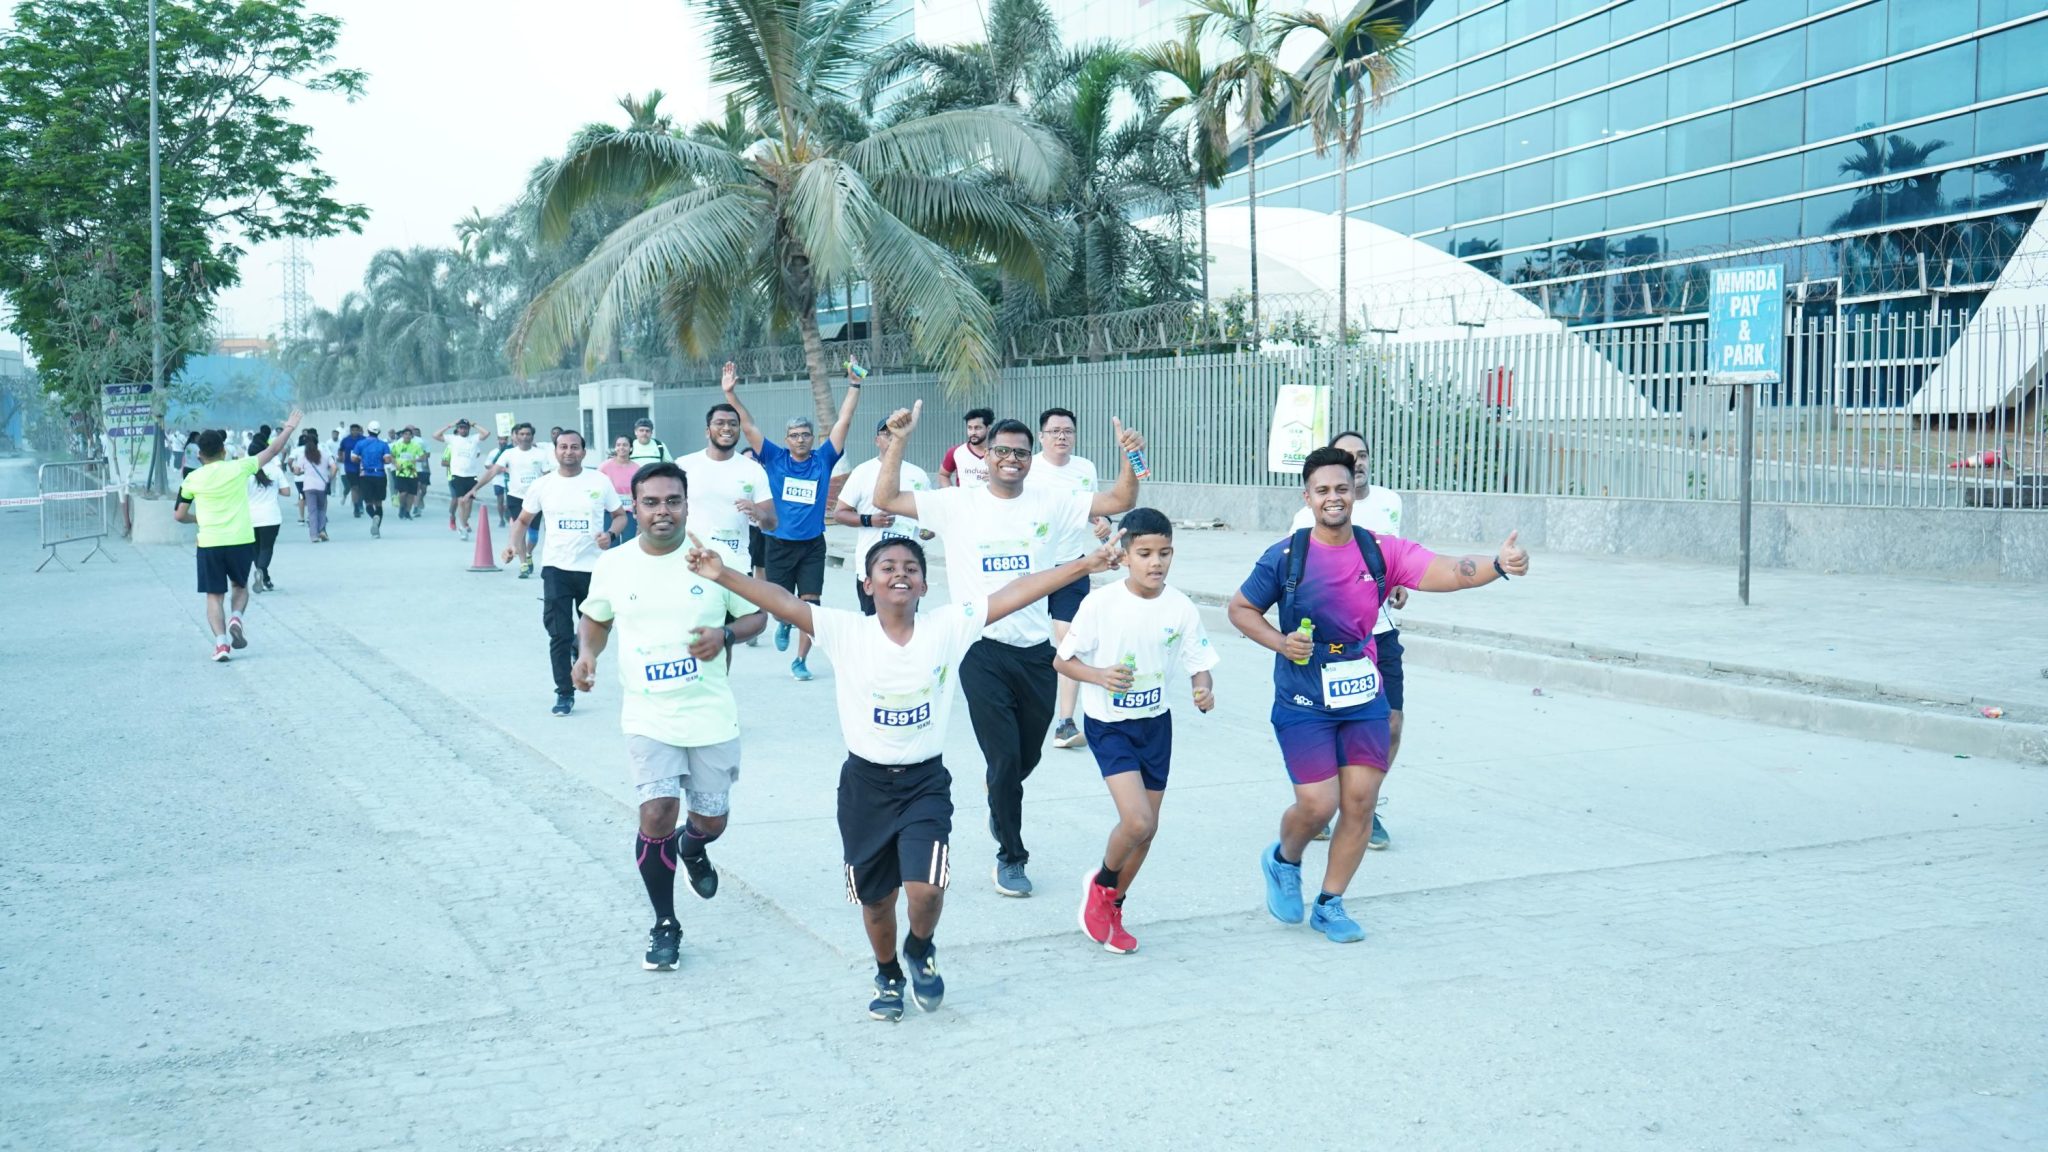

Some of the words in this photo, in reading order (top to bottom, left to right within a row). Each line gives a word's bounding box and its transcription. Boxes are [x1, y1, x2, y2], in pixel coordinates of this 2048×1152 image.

[1716, 269, 1777, 294] MMRDA
[1730, 294, 1761, 318] PAY
[1738, 319, 1751, 341] &
[1722, 343, 1765, 367] PARK
[984, 556, 1028, 571] 16803
[648, 659, 695, 681] 17470
[1331, 676, 1374, 696] 10283
[876, 704, 928, 725] 15915
